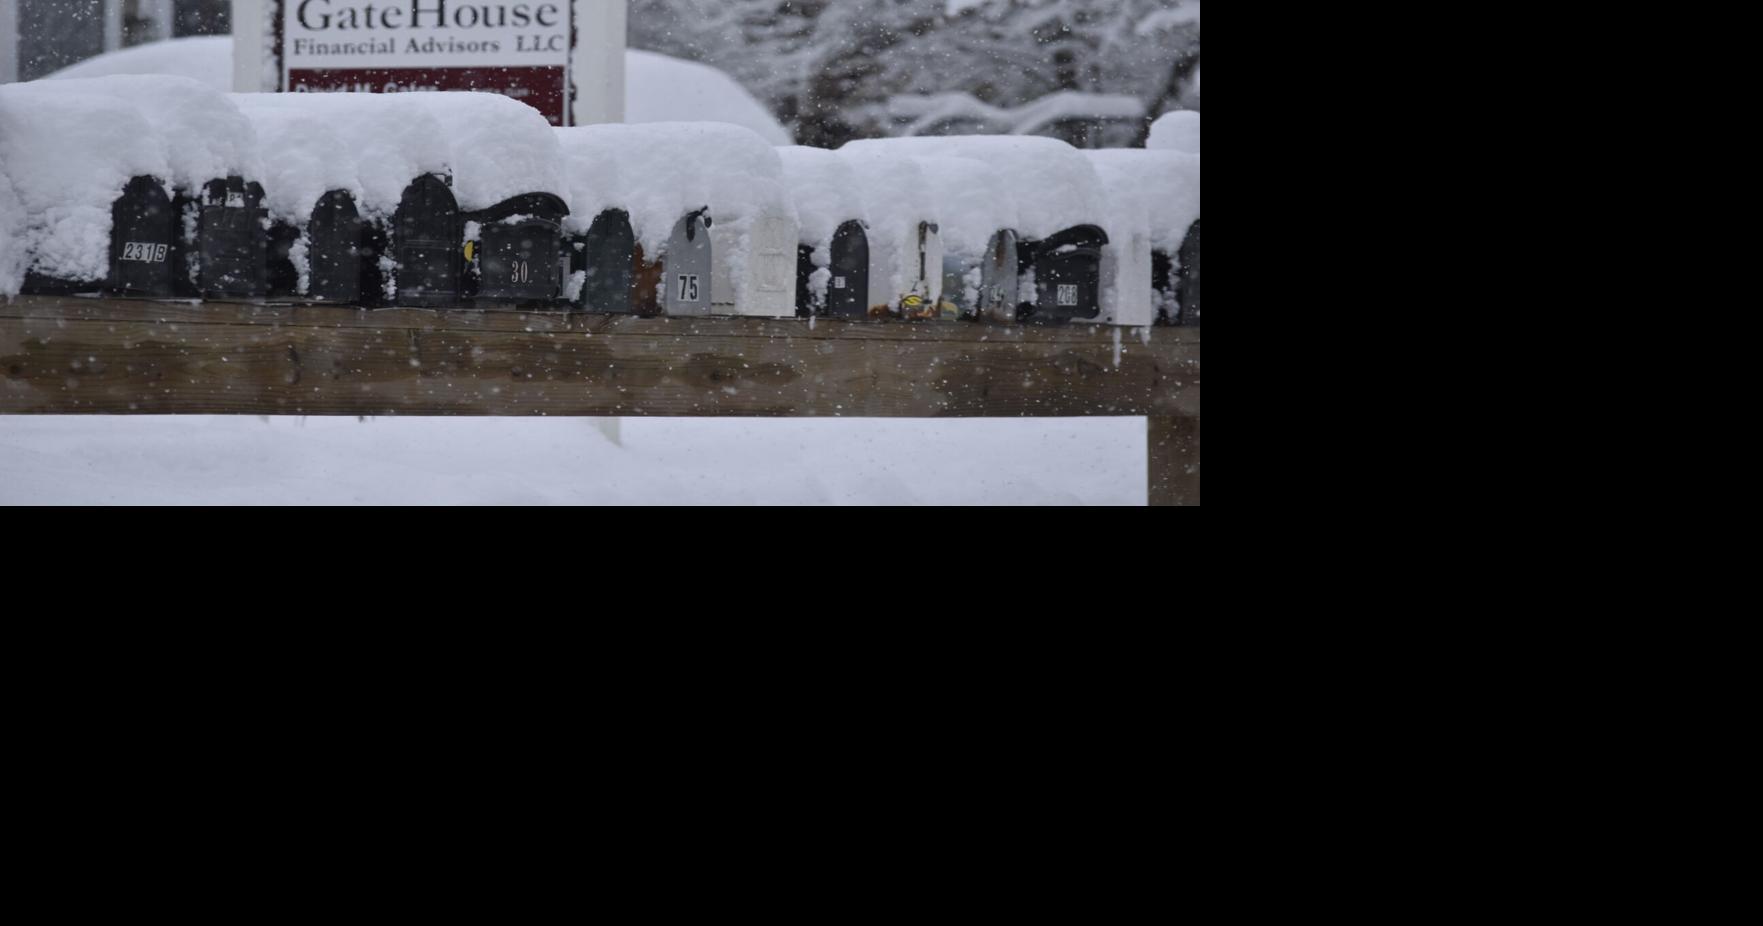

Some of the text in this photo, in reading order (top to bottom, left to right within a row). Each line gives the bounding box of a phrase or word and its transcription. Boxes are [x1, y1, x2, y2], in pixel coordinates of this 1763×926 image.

[296, 0, 559, 31] GateHouse
[293, 34, 564, 56] Financial Advisors LLC
[511, 260, 528, 284] 30
[679, 275, 698, 300] 75
